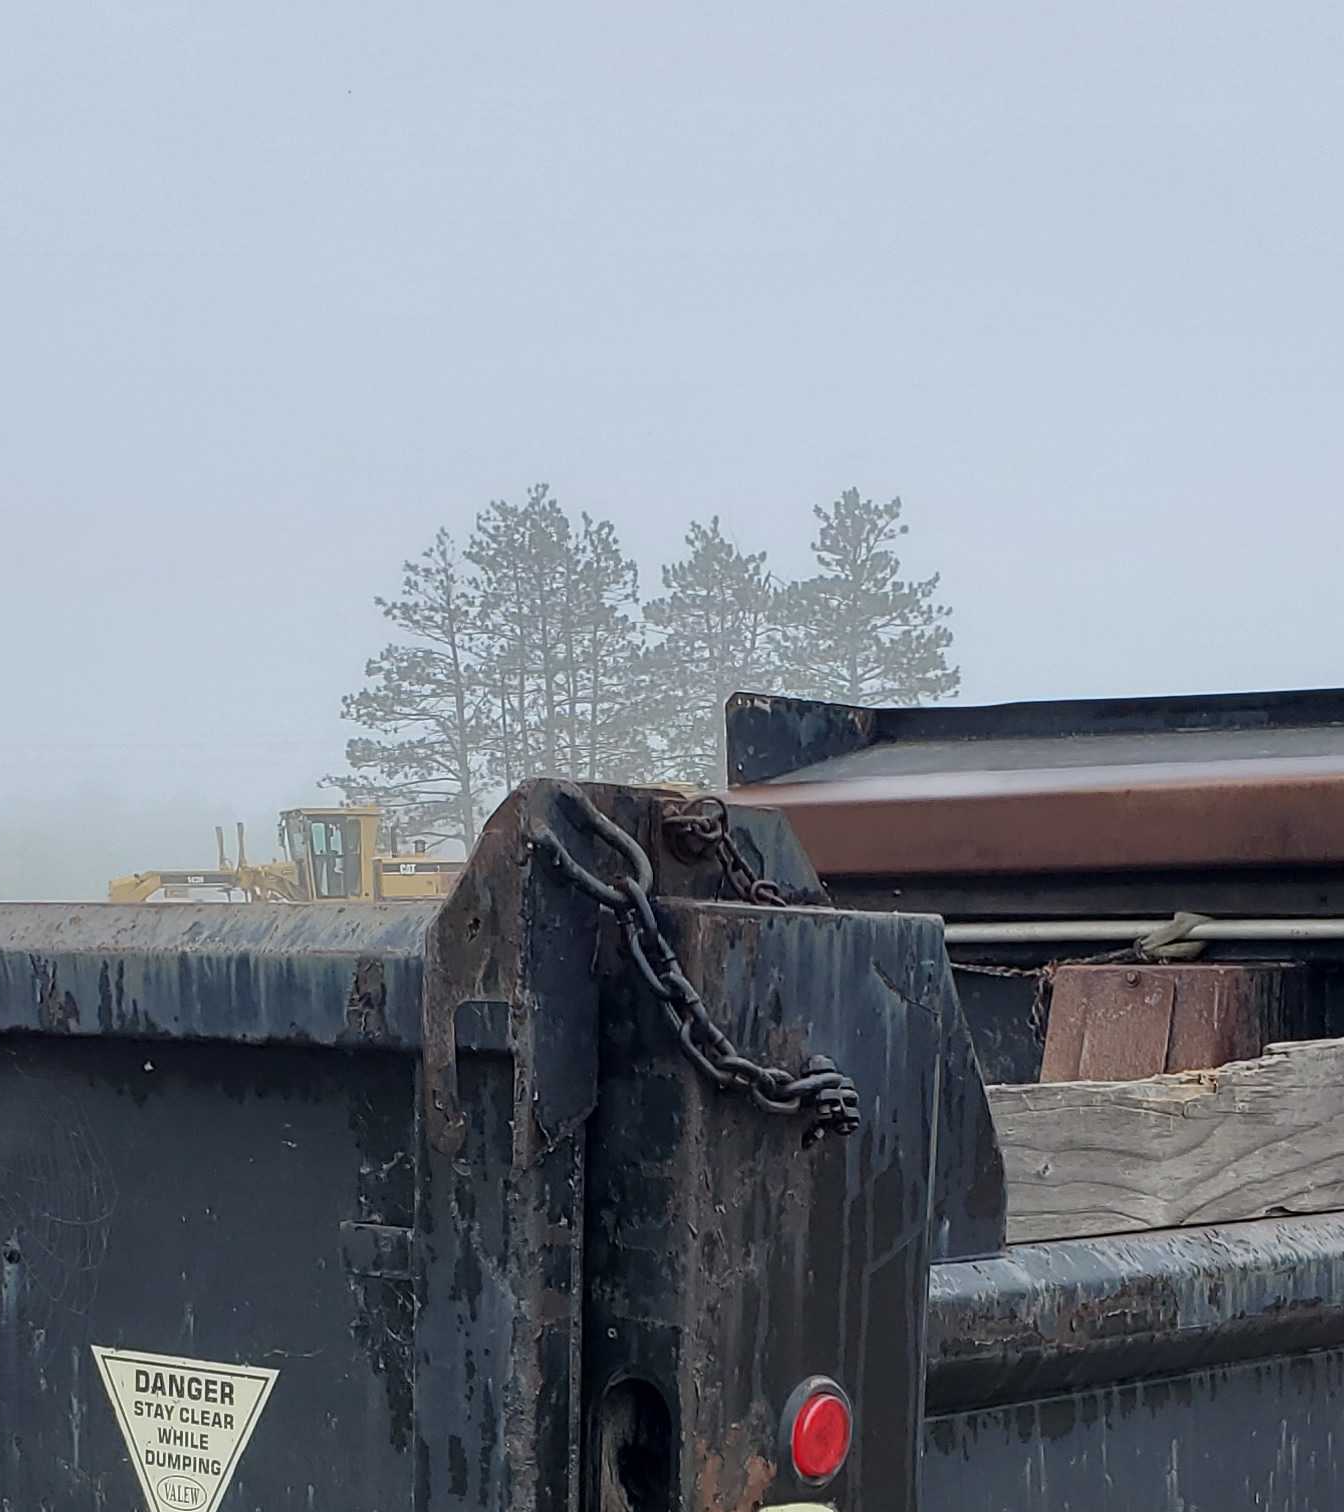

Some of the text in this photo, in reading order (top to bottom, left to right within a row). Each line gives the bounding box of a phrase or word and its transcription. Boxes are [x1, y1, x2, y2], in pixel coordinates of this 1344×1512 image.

[135, 1369, 235, 1405] DANGER
[134, 1400, 234, 1430] STAY CLEAR
[158, 1427, 209, 1450] WHILE
[145, 1450, 222, 1476] DUMPING
[164, 1483, 201, 1505] VALEW
